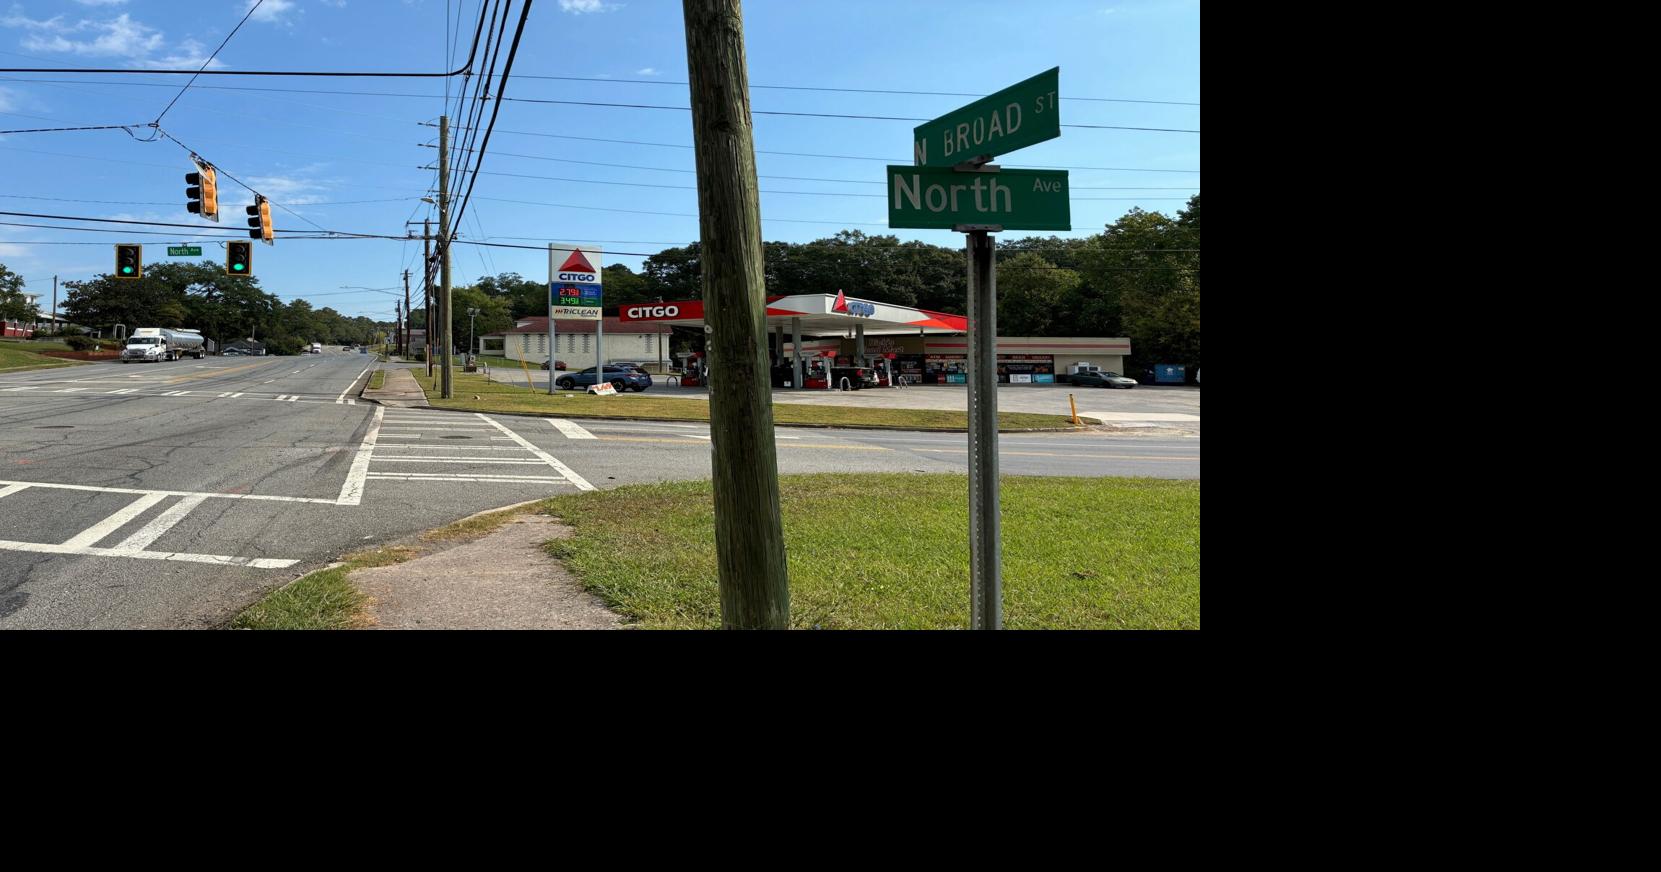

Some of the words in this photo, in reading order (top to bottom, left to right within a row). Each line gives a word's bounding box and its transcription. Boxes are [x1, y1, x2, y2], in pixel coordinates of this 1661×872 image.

[914, 138, 927, 166] N
[943, 102, 1022, 156] BROAD
[1034, 91, 1056, 113] ST
[894, 174, 1012, 212] North
[1032, 178, 1062, 192] Ave
[170, 247, 189, 255] North
[559, 273, 595, 282] CITGO
[627, 305, 679, 319] CITGO
